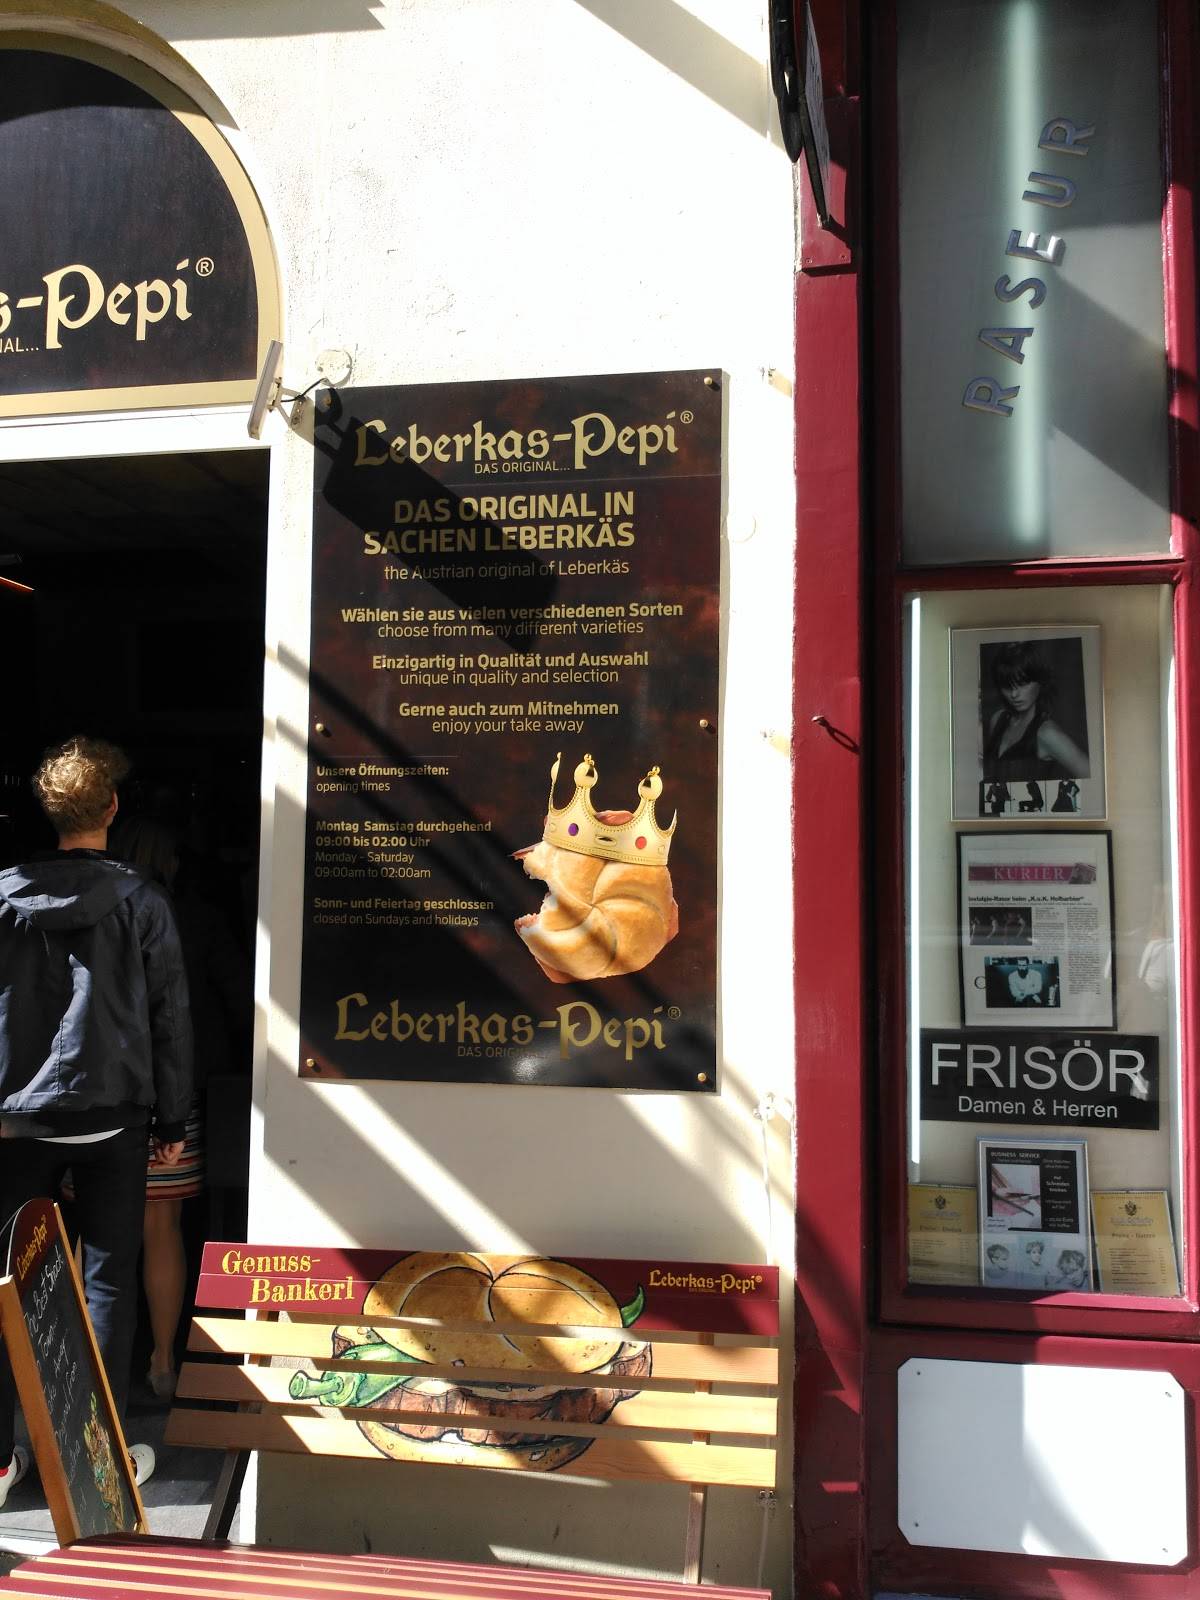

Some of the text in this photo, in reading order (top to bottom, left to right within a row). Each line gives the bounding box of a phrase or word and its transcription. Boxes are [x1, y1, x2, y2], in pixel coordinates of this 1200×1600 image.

[962, 117, 1095, 417] RASEUR
[474, 464, 499, 474] DAS
[394, 491, 634, 525] DAS ORIGINAL IN
[364, 517, 635, 555] SACHEN LEBERKÄS
[385, 559, 630, 580] the Austrian original of Leberkäs
[341, 603, 683, 623] Wählen sie aus vielen verschiedenen Sorten
[378, 619, 644, 640] choose from many different varieties
[372, 651, 649, 672] Einzigartig in Qualität und Auswahl
[400, 668, 619, 688] unique in quality and selection
[399, 701, 619, 717] Gerne auch zum Mitnehmen
[432, 717, 584, 735] enjoy your take away
[316, 763, 449, 777] Unsere Öffnungszeiten:
[316, 781, 391, 793] opening times
[316, 821, 492, 835] Montag Samstag durchgehend
[315, 836, 431, 847] 09:00 bis 02:00 Uhr
[315, 851, 357, 864] Monday
[367, 851, 415, 864] Saturday
[315, 867, 431, 878] 09:00am to 02:00am
[994, 868, 1065, 880] KURIER
[314, 897, 494, 911] Sonn- und Feiertag geschlossen
[313, 913, 479, 927] closed on Sundays and holidays
[457, 1046, 482, 1058] DAS
[931, 1040, 1149, 1094] FRISÖR
[958, 1096, 1118, 1119] Damen & Herren
[221, 1250, 321, 1274] Genuss-
[249, 1276, 356, 1304] Bankerl
